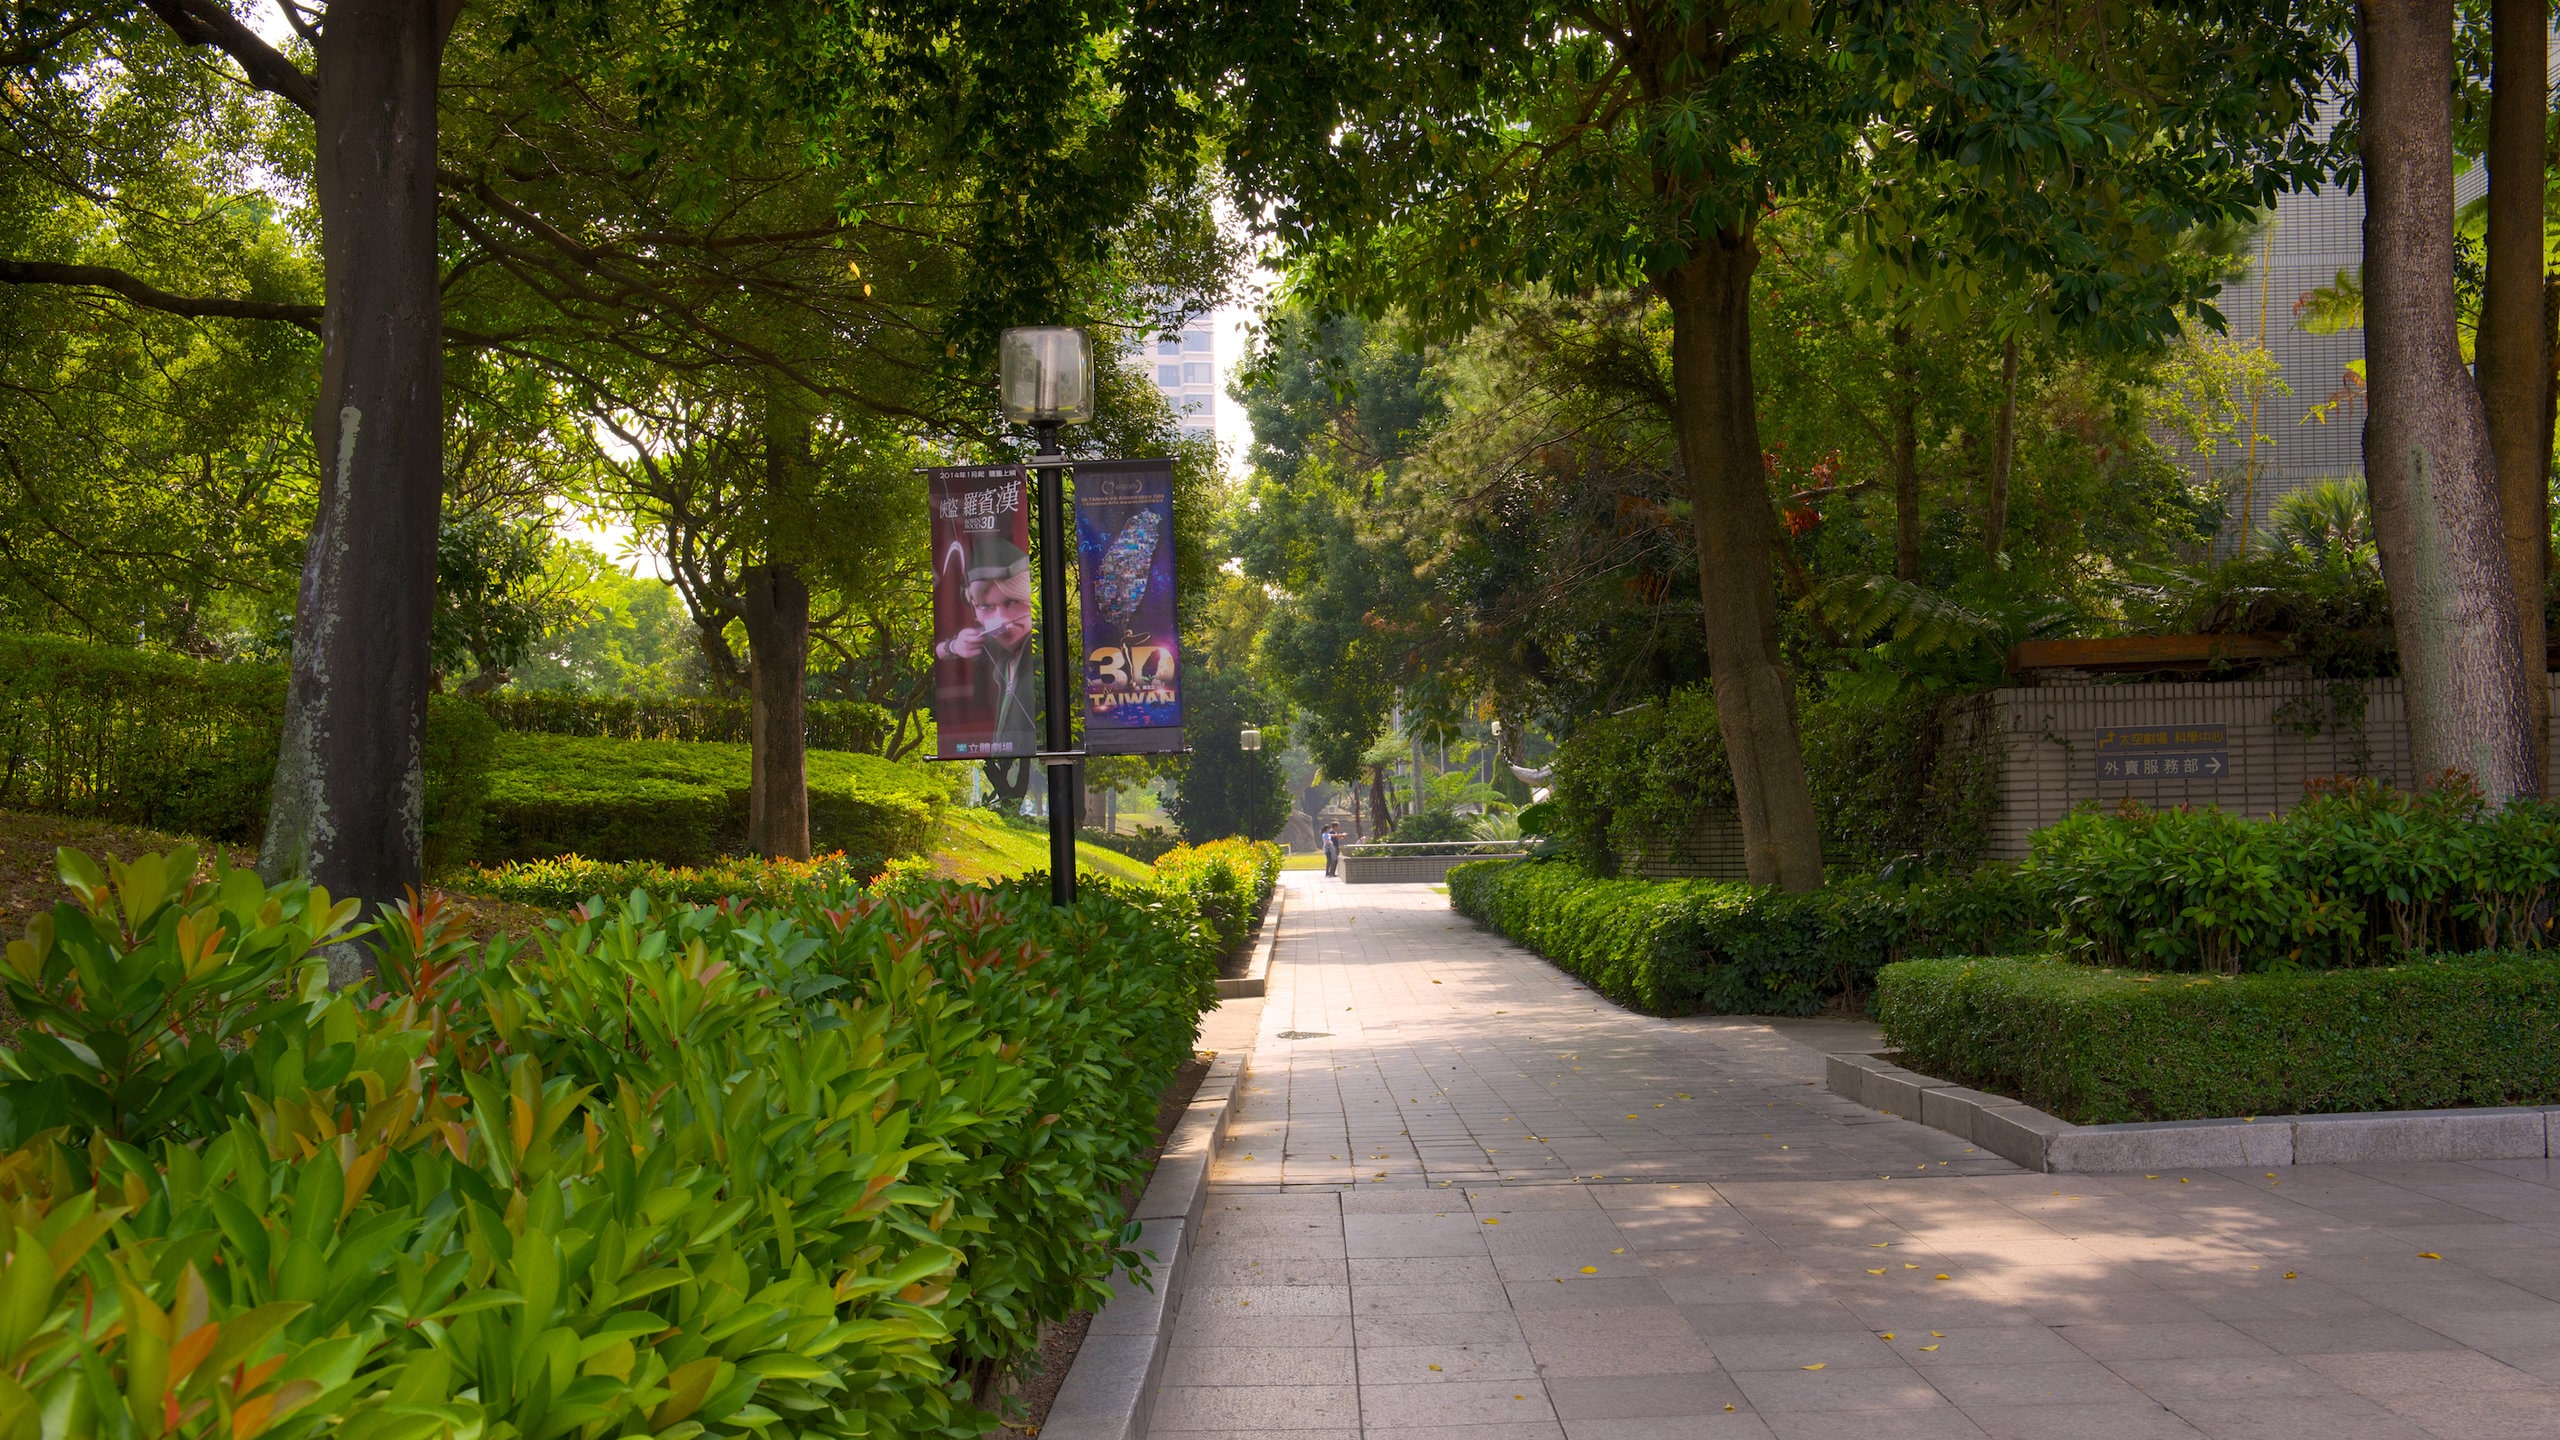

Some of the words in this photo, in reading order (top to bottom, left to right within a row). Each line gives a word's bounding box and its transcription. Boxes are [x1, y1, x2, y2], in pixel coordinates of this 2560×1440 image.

[962, 480, 1022, 517] 羅賓漢
[980, 515, 995, 530] 3D
[1089, 645, 1175, 688] 3D
[1089, 690, 1176, 706] TAIWAN
[2174, 730, 2224, 744] 科學中心
[2104, 758, 2199, 776] 外賣服務部
